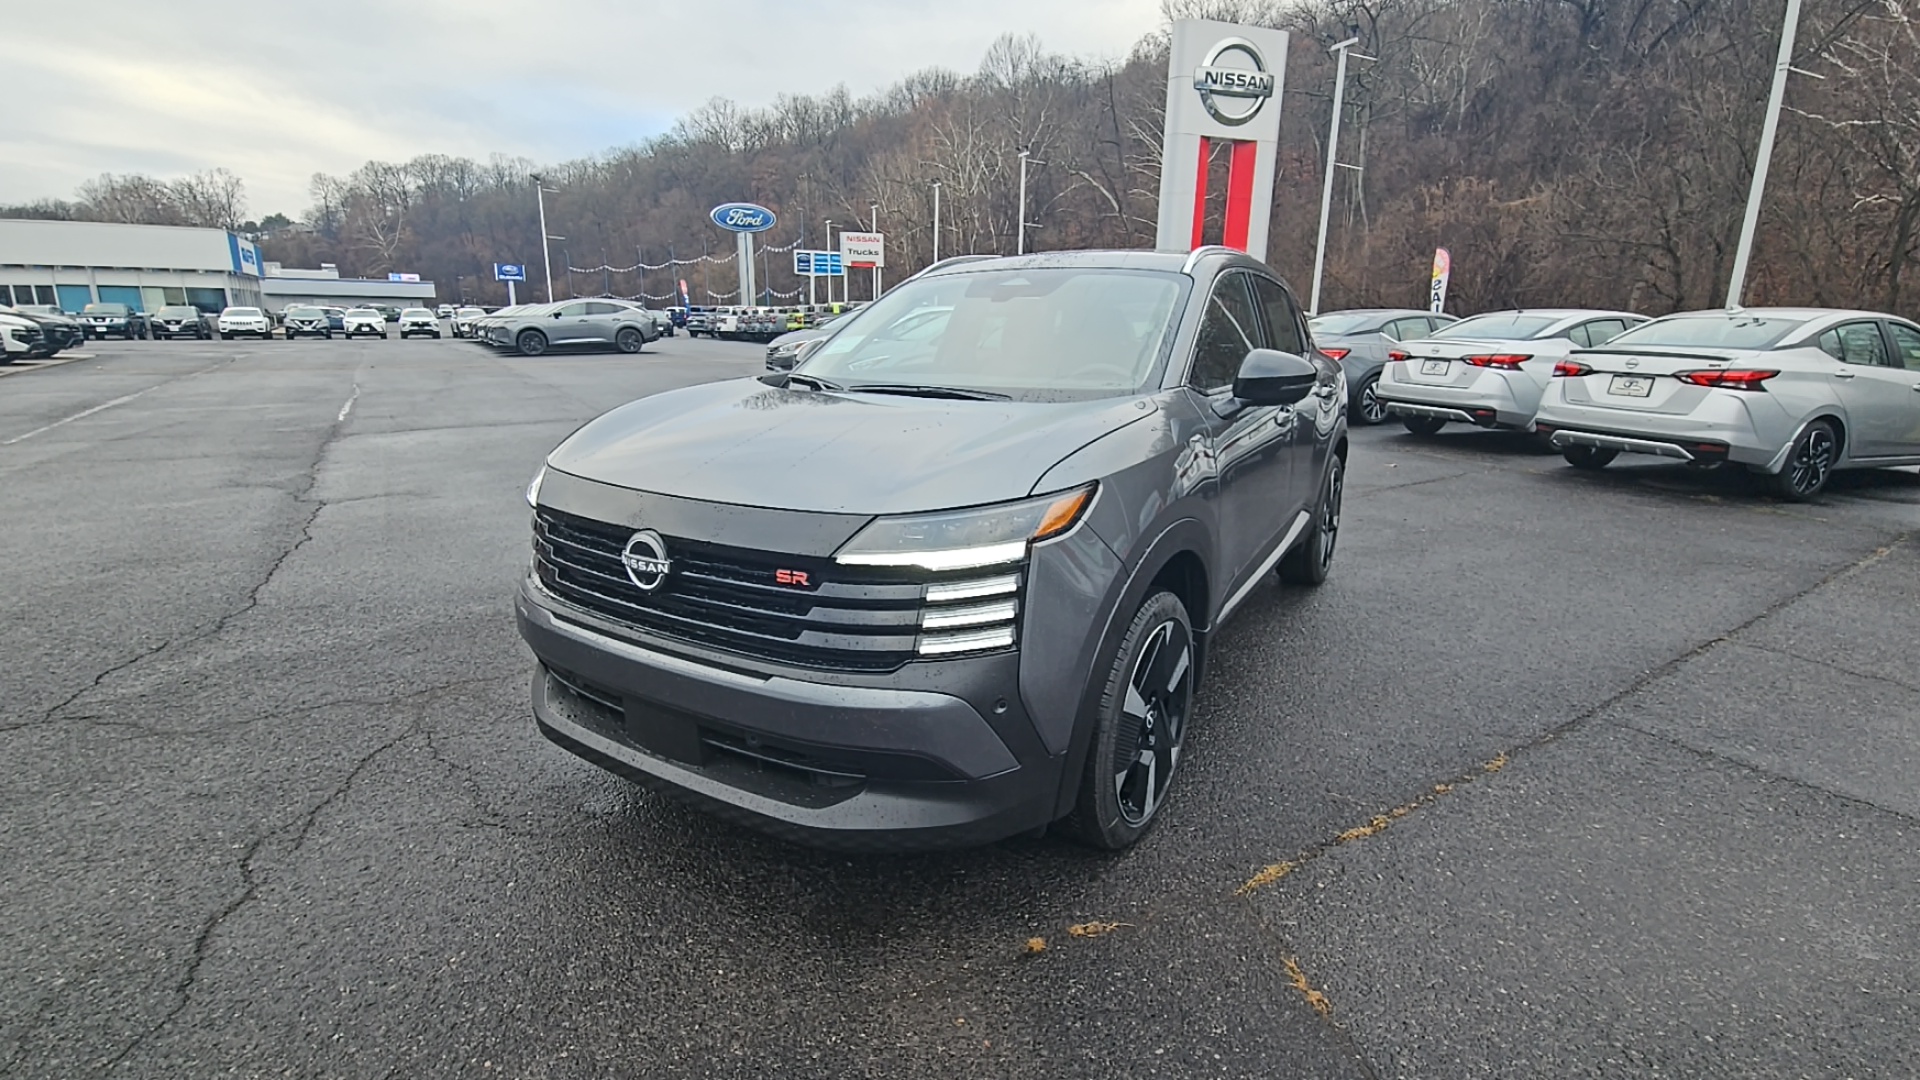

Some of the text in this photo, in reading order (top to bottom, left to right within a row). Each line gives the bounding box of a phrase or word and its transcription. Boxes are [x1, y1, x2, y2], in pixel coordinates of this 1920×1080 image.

[1205, 70, 1268, 91] NISSAN
[726, 208, 763, 226] Ford
[846, 236, 880, 244] NISSAN
[848, 248, 879, 256] Trucks
[622, 557, 668, 573] NISSAN
[775, 568, 810, 586] SR
